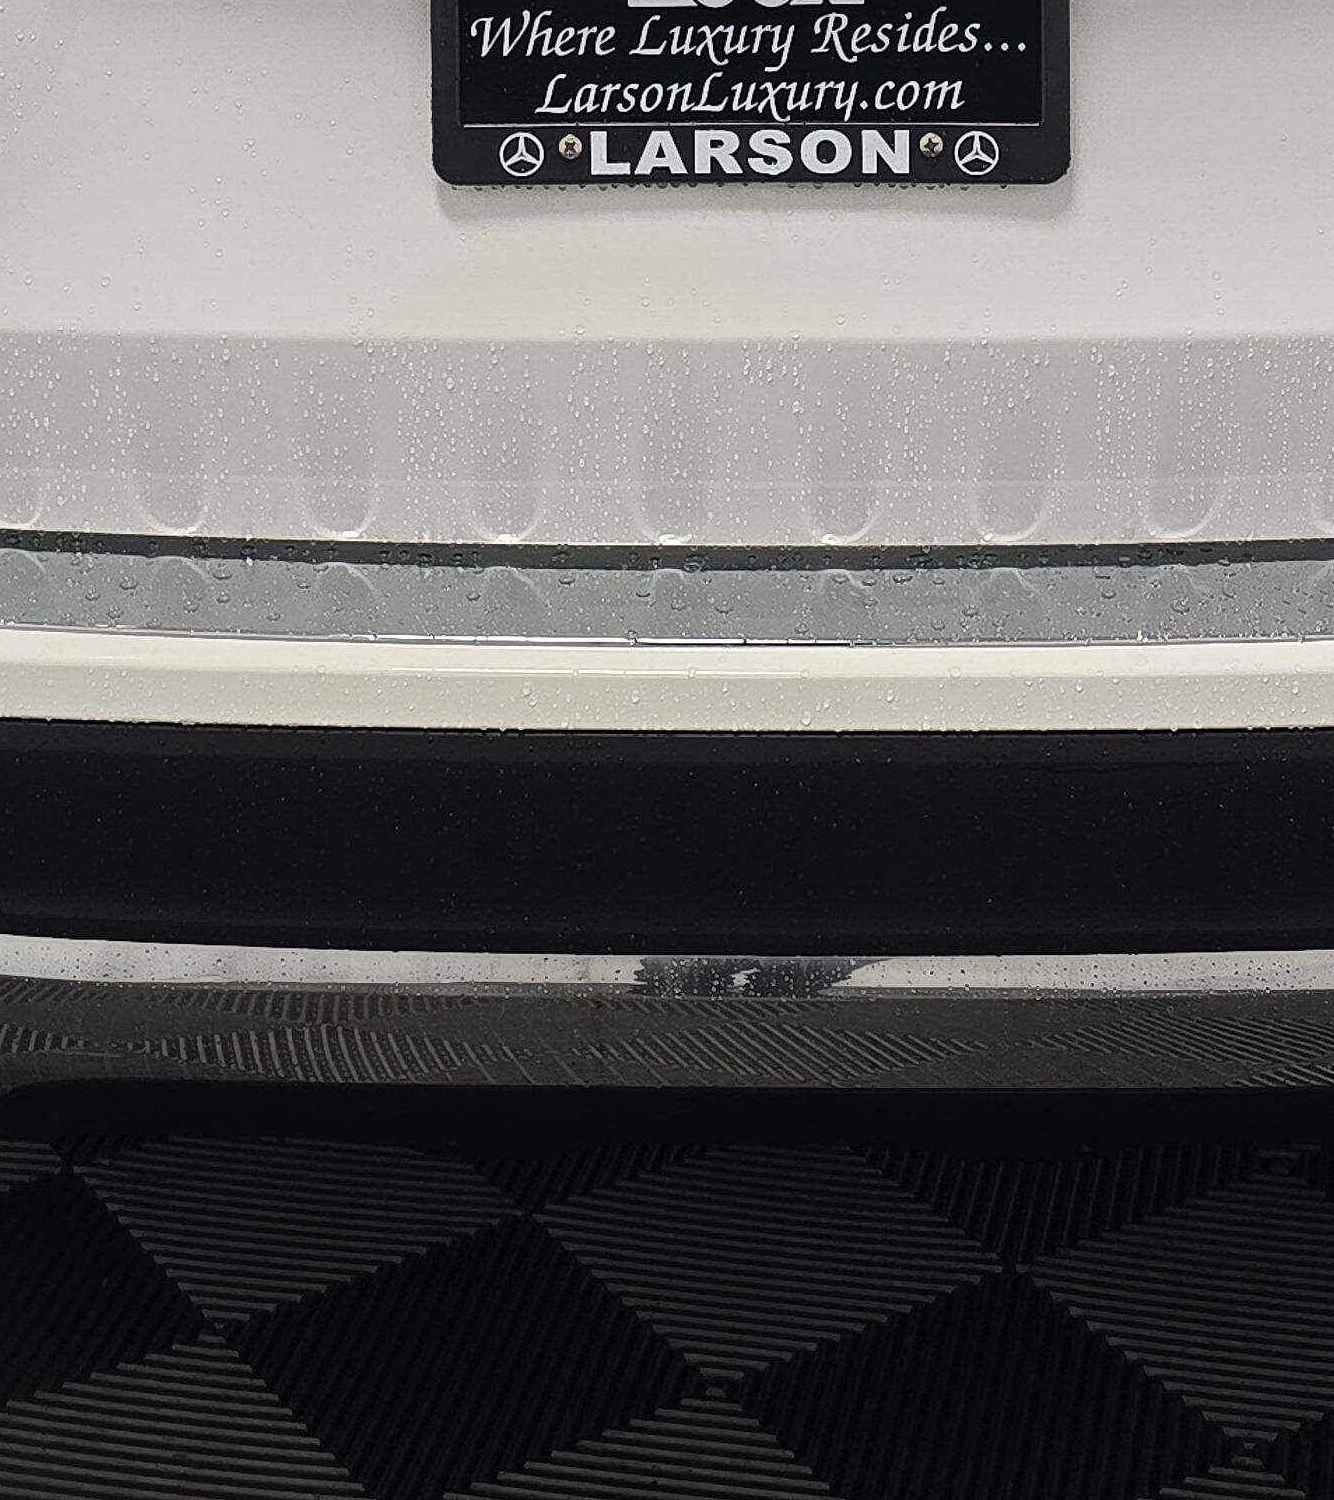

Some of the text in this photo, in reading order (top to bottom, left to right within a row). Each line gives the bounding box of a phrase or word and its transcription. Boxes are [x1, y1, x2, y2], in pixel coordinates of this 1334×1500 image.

[470, 6, 1028, 72] Where Luxury Resides...
[535, 72, 965, 121] LarsonLuxury.com
[590, 130, 910, 175] LARSON
